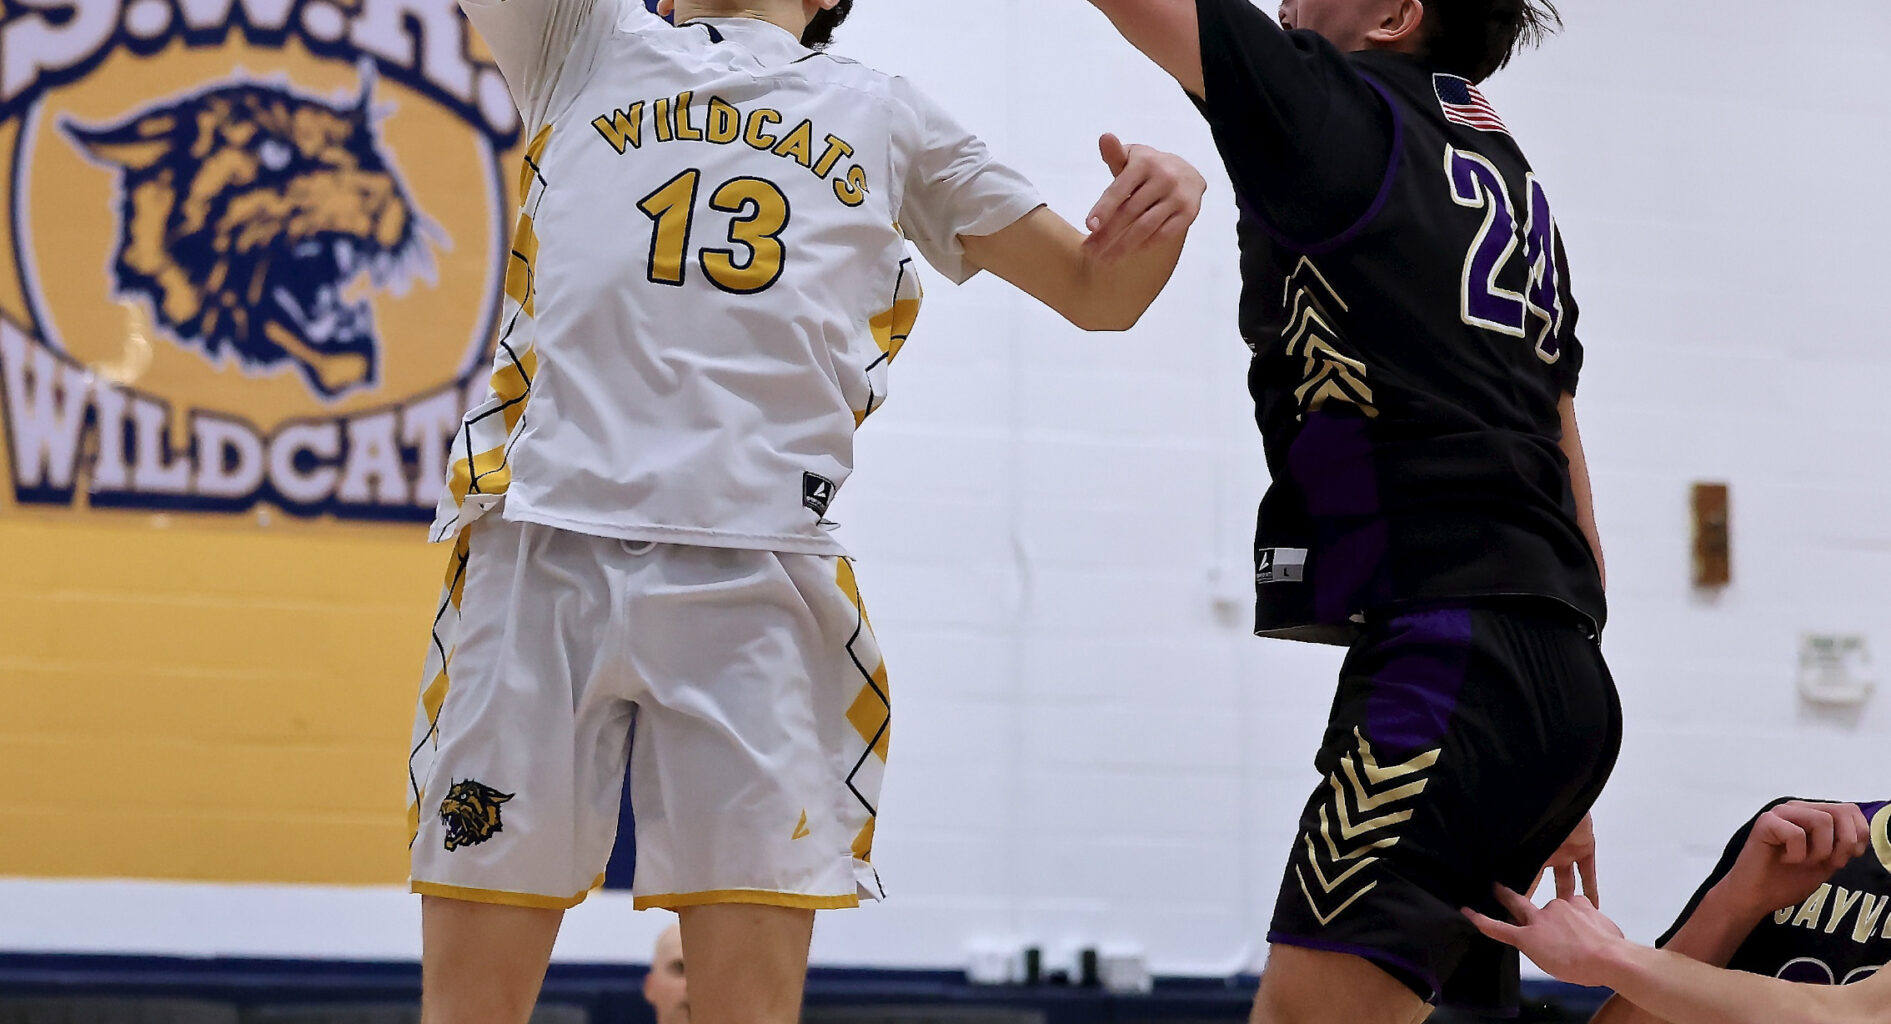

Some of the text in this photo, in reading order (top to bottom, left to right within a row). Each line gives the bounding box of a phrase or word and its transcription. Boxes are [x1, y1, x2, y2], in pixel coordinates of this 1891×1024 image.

[591, 90, 870, 207] WILDCATS
[636, 167, 791, 295] 13
[1443, 142, 1564, 364] 24
[0, 314, 488, 513] WILDCAT
